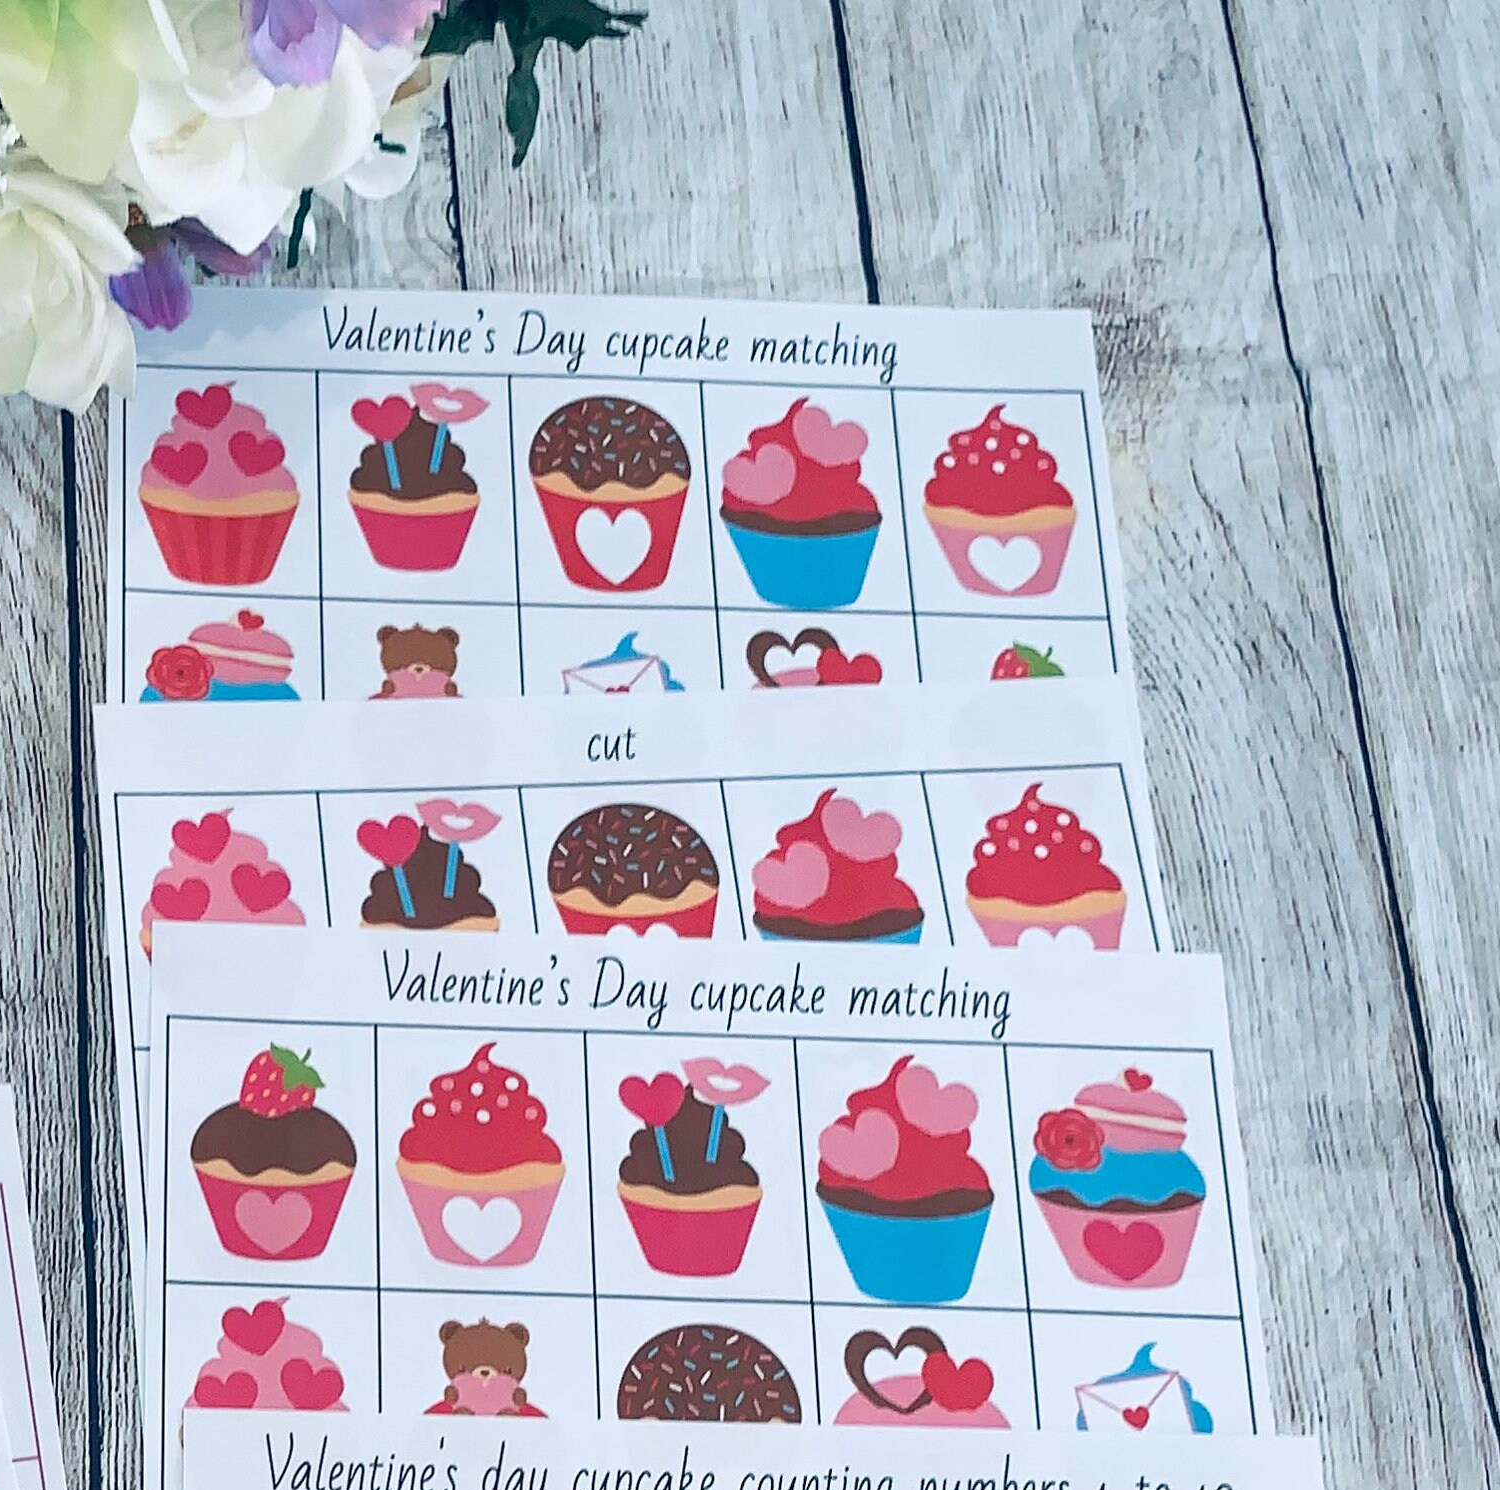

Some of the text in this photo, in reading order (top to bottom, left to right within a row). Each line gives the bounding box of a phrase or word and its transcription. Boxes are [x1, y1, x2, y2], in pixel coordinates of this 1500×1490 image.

[322, 305, 900, 384] Valentine's Day cupcake matching
[587, 727, 636, 762] cut
[382, 948, 1012, 1040] Valentine's Day cupcake matching
